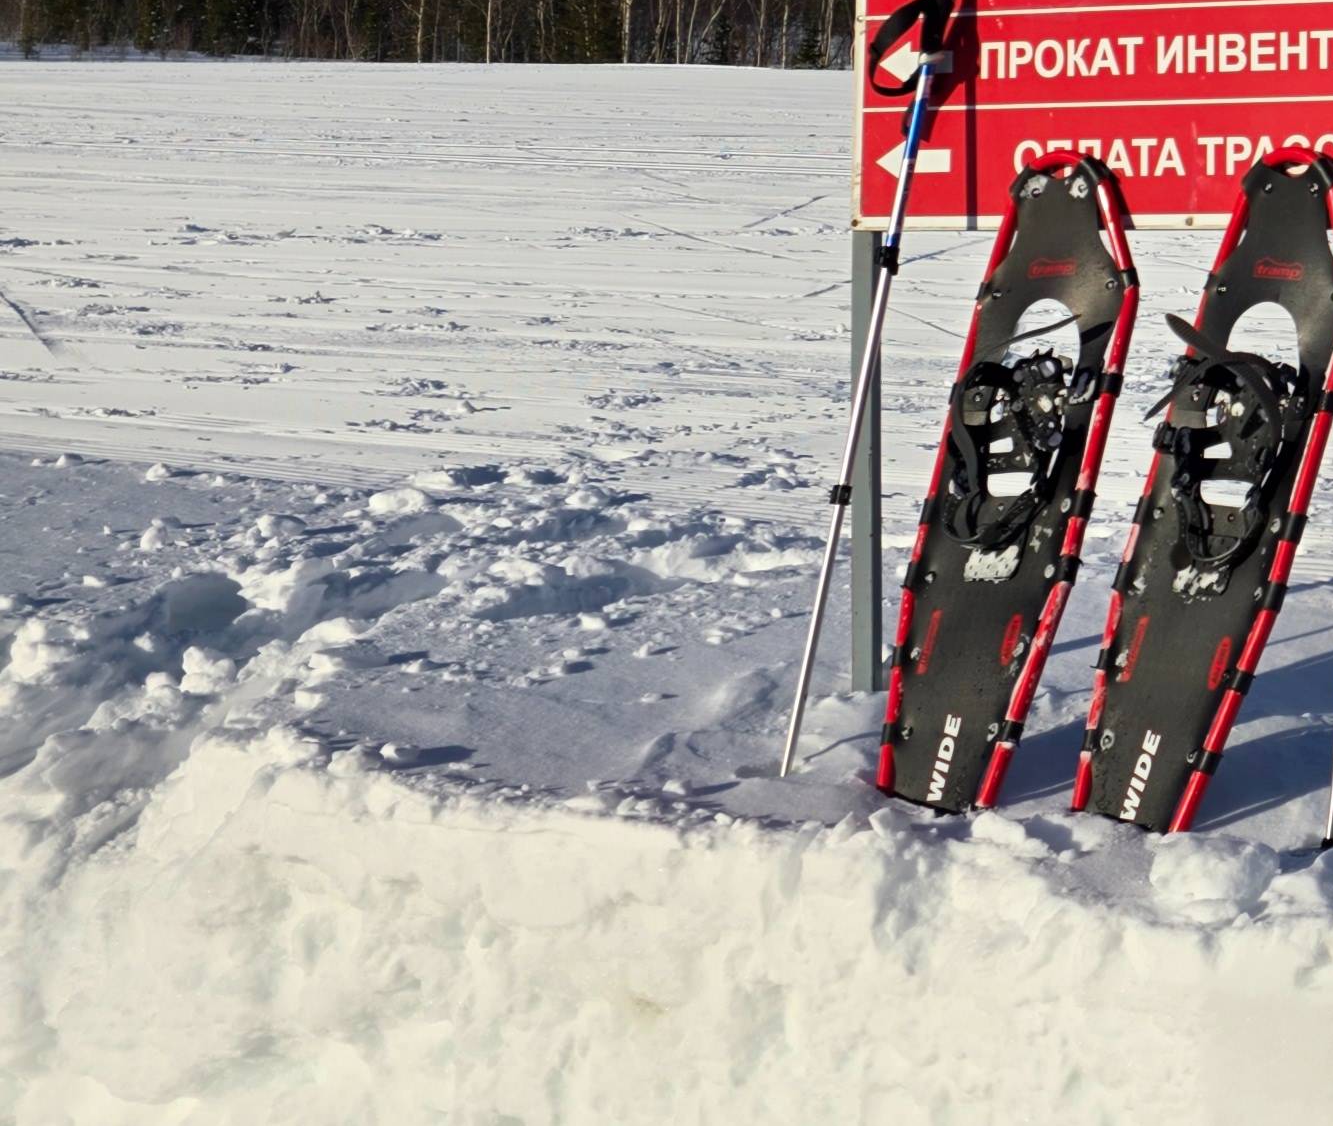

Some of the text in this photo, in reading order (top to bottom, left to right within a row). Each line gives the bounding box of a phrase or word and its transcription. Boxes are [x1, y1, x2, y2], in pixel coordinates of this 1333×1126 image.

[979, 36, 1145, 81] ПРОКАТ
[925, 713, 962, 802] WIDE
[1119, 729, 1162, 821] WIDE
